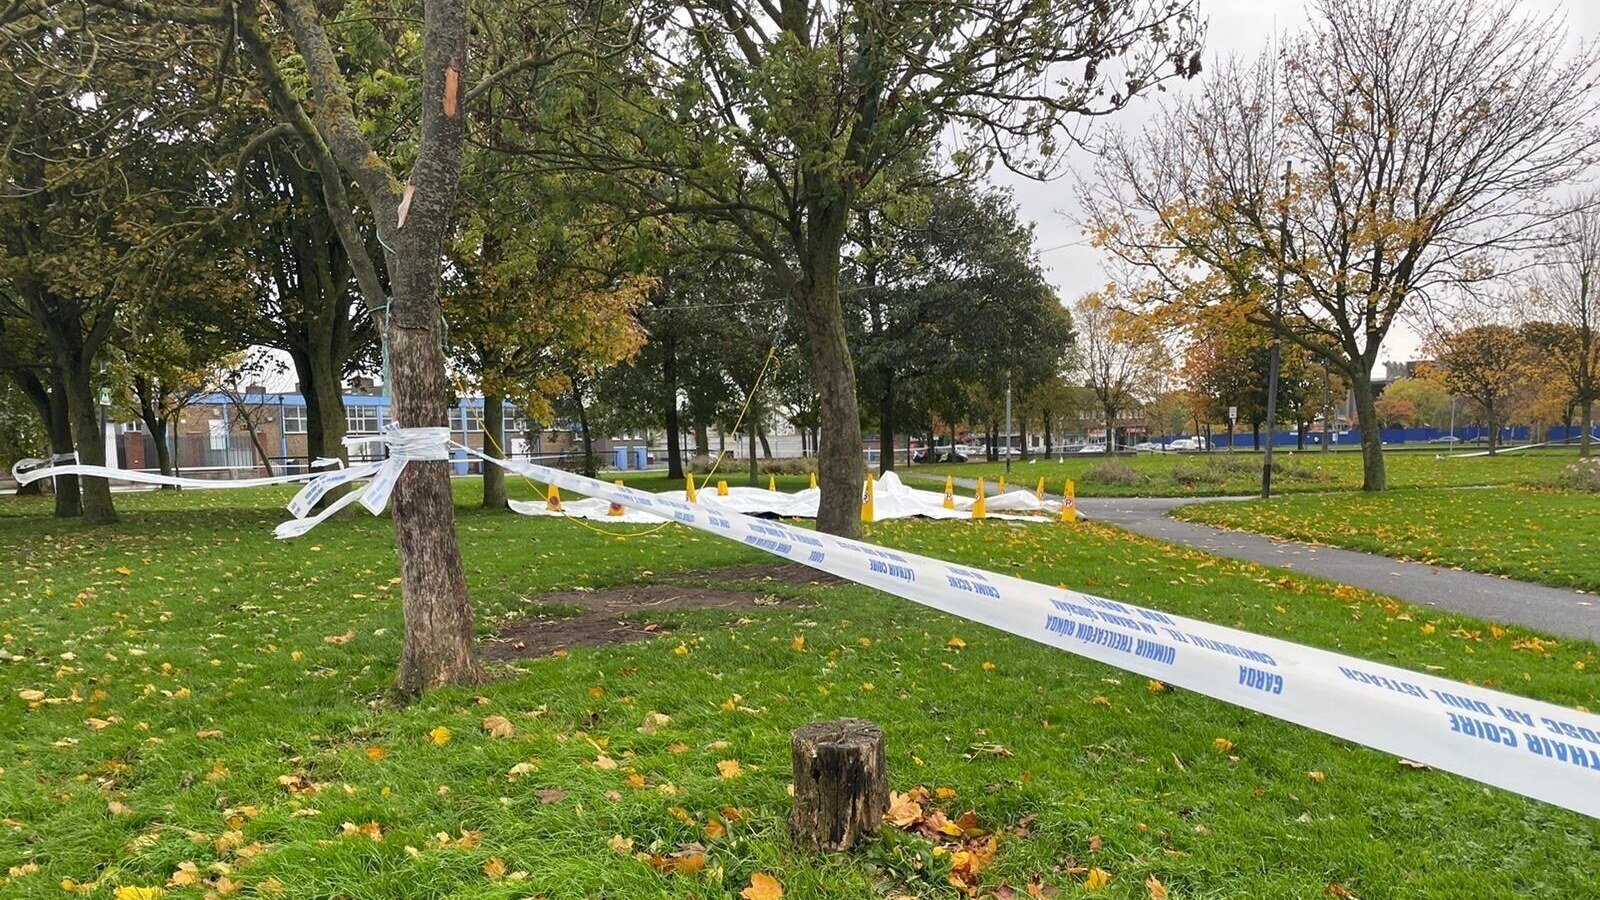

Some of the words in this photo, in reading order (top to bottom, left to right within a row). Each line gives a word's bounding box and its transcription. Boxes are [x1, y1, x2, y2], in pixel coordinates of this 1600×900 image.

[947, 575, 972, 591] SCENE
[971, 582, 1000, 599] CRIME
[1044, 615, 1075, 636] RÚNDA
[1136, 639, 1176, 665] UIMHIR
[1185, 634, 1277, 667] CONFIDENTIAL
[1239, 665, 1283, 695] GARDA
[1338, 666, 1429, 700] ISTEACH
[1429, 689, 1495, 717] DHUL
[1497, 706, 1535, 727] AR
[1446, 712, 1518, 748] COIRE
